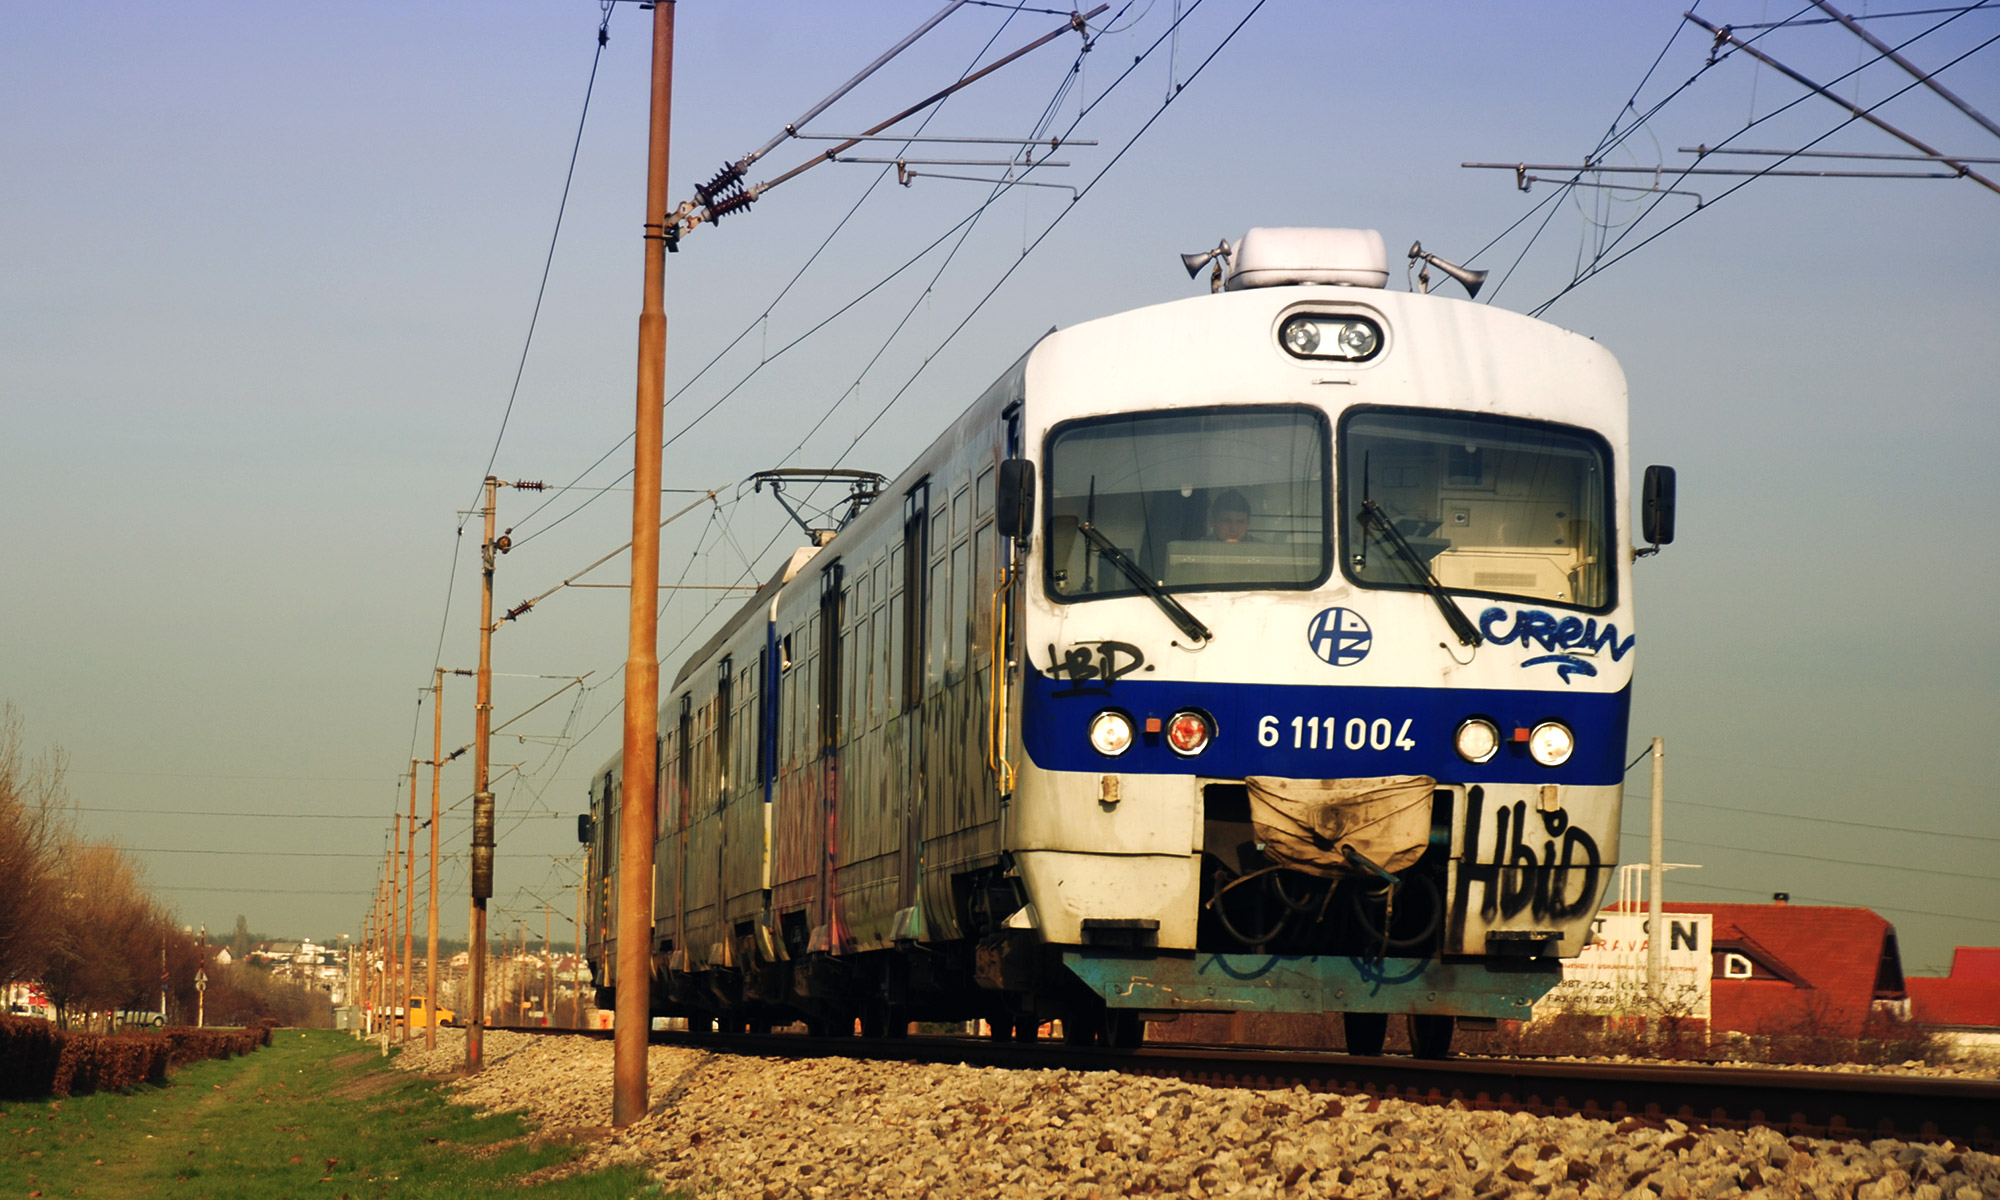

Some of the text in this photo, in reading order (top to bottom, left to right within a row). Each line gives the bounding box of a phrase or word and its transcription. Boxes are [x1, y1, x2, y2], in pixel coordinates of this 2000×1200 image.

[1258, 715, 1416, 751] 6 111 004
